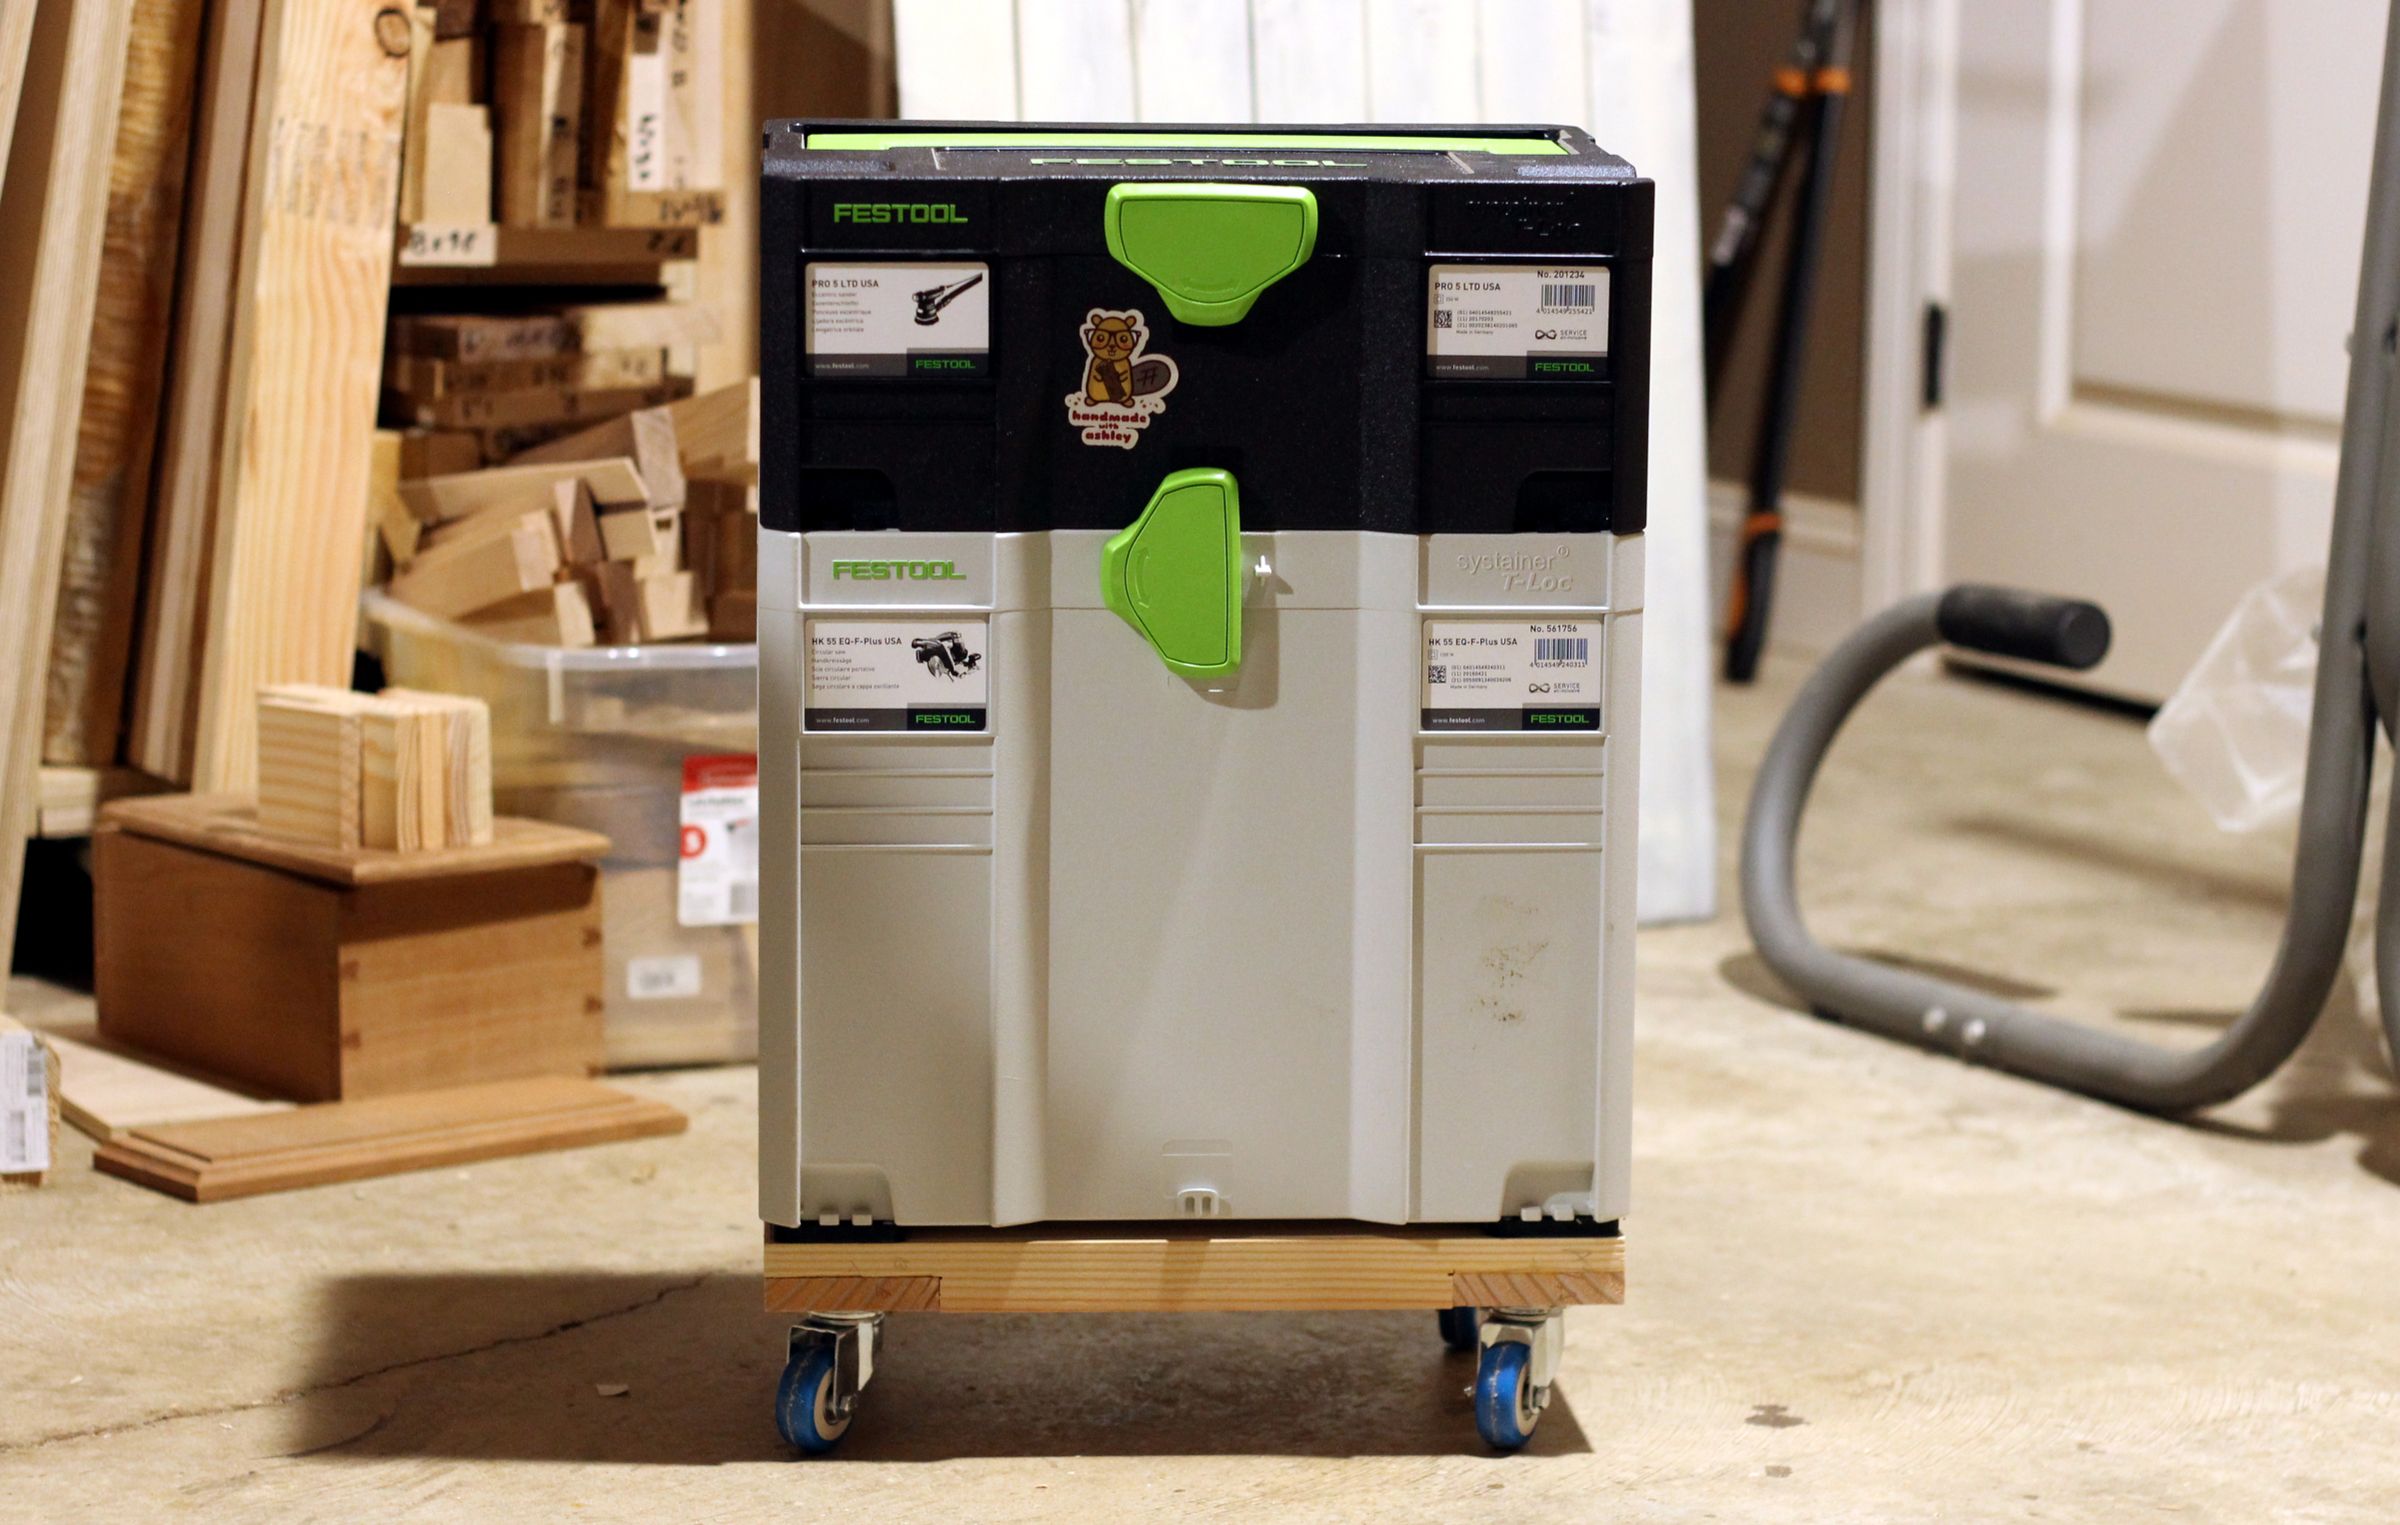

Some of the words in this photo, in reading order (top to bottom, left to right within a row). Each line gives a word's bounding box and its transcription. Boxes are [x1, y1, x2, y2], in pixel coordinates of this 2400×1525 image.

[833, 203, 969, 224] FESTOOL
[1536, 270, 1552, 279] No.
[1553, 270, 1585, 279] 201234
[811, 279, 831, 288] PRO
[832, 280, 839, 288] 5
[840, 279, 858, 288] LTD
[860, 279, 879, 288] USA
[1434, 282, 1453, 291] PRO
[1455, 282, 1461, 291] 5
[1463, 283, 1481, 291] LTD
[1482, 282, 1501, 291] USA
[915, 359, 977, 369] FESTOOL
[1534, 362, 1595, 372] FESTOOL
[1072, 411, 1147, 422] handmade
[1085, 430, 1132, 444] ashley
[832, 559, 967, 581] FESTOOL
[1529, 624, 1545, 633] No.
[1546, 624, 1578, 633] 561756
[811, 637, 825, 646] HK
[826, 638, 837, 646] 55
[838, 637, 883, 646] EQ-F-Plus
[884, 637, 903, 645] USA
[1428, 638, 1442, 646] HK
[1443, 638, 1454, 646] 55
[1455, 638, 1499, 646] EQ-F-Plus
[1500, 637, 1518, 646] USA
[915, 714, 976, 724] FESTOOL
[1530, 714, 1590, 724] FESTOOL
